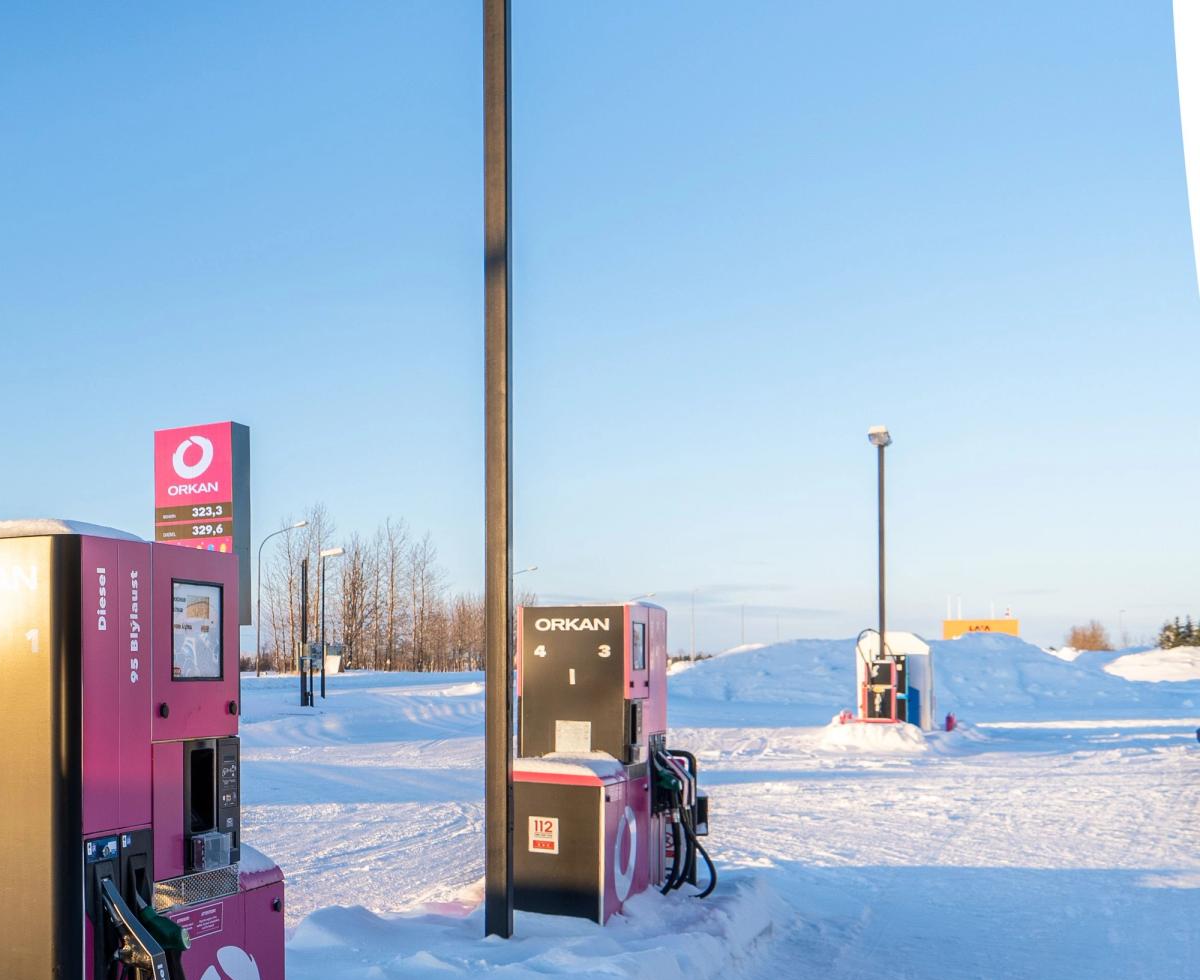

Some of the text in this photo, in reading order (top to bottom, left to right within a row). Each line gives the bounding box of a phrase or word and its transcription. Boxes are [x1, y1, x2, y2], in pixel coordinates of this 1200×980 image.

[167, 482, 219, 496] ORKAN
[191, 506, 223, 517] 323,3
[192, 524, 224, 536] 329,6
[96, 567, 107, 631] Diesel
[534, 618, 610, 631] ORKAN
[25, 628, 40, 653] 1
[533, 645, 547, 658] 4
[597, 644, 612, 658] 3
[130, 658, 139, 683] 95
[534, 820, 553, 833] 112
